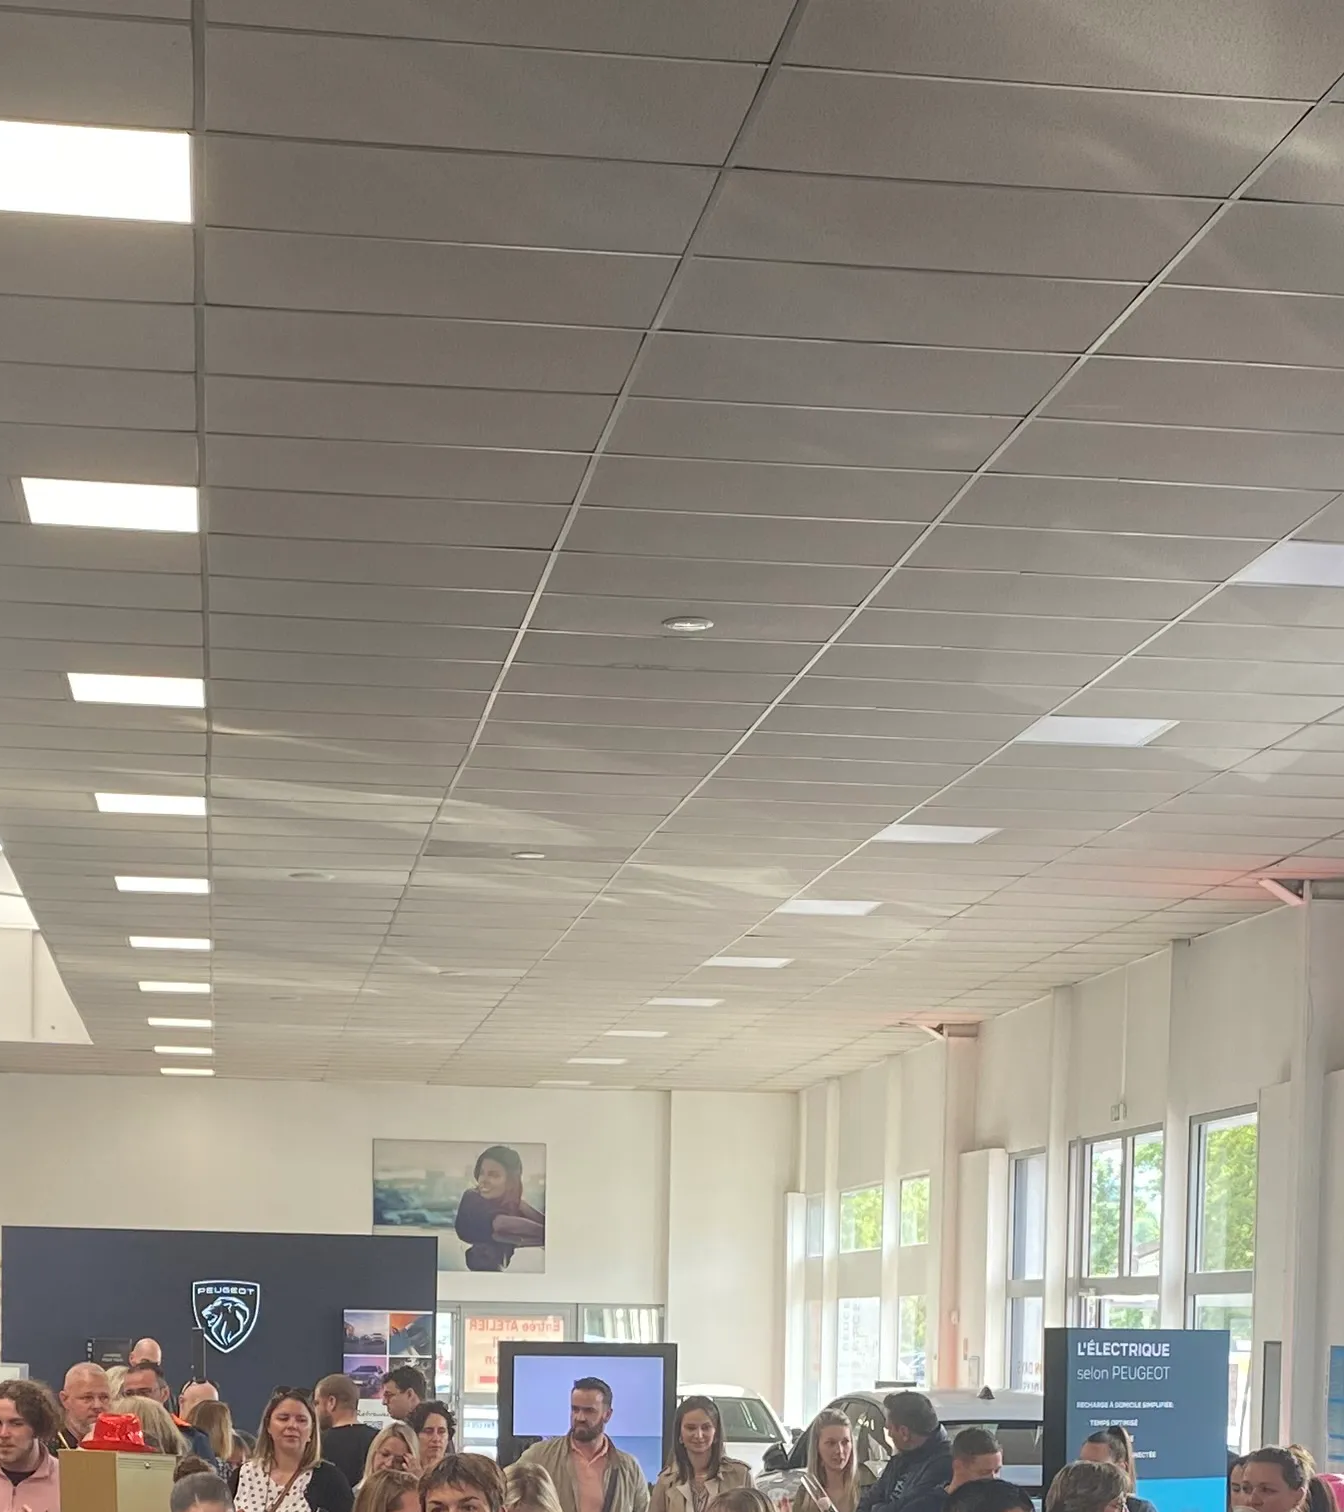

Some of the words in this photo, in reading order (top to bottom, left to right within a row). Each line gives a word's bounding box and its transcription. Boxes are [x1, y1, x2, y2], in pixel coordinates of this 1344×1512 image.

[197, 1286, 255, 1295] PEUGEOT
[1077, 1339, 1171, 1357] L'ÉLECTRIQUE
[1076, 1366, 1109, 1380] selon
[1112, 1365, 1171, 1381] PEUGEOT
